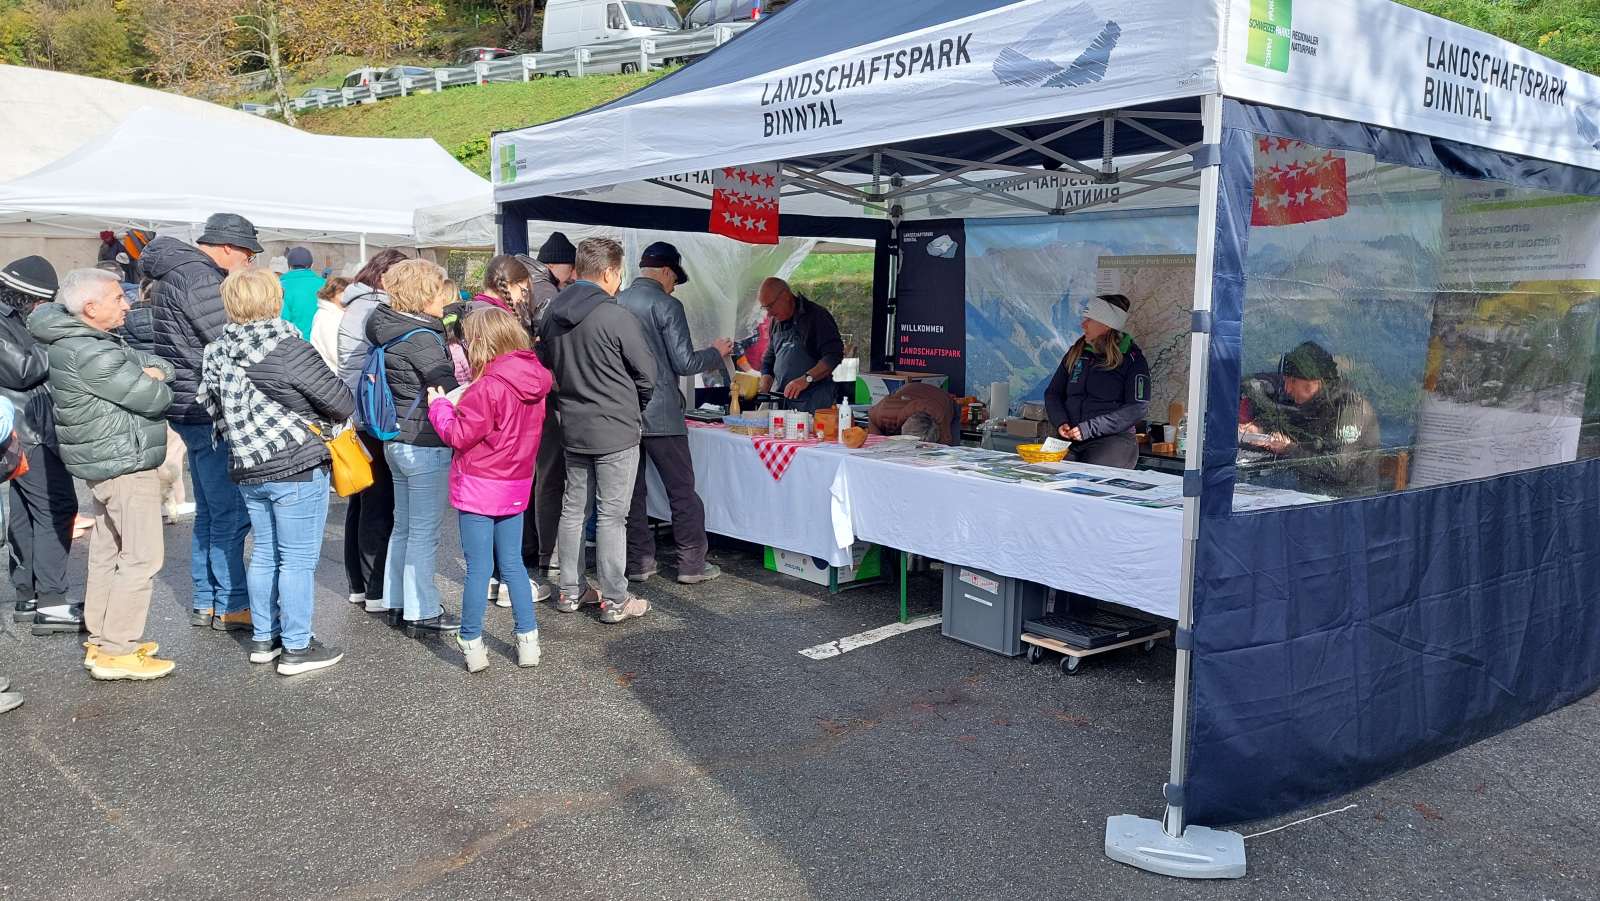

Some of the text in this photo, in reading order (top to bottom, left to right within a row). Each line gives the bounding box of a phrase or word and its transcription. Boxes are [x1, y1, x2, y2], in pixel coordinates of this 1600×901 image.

[1291, 30, 1319, 46] REGIONALER
[1264, 38, 1273, 68] PARCS
[1290, 41, 1317, 57] NATURPARK
[760, 32, 973, 107] LANDSCHAFTSPARK
[1426, 36, 1568, 107] LANDSCHAFTSPARK
[1423, 76, 1492, 122] BINNTAL
[763, 98, 843, 138] BINNTAL
[900, 323, 944, 334] WILLKOMMEN
[900, 335, 909, 343] IM
[900, 346, 961, 358] LANDSCHAFTSPARK
[899, 357, 927, 367] BINNTAL
